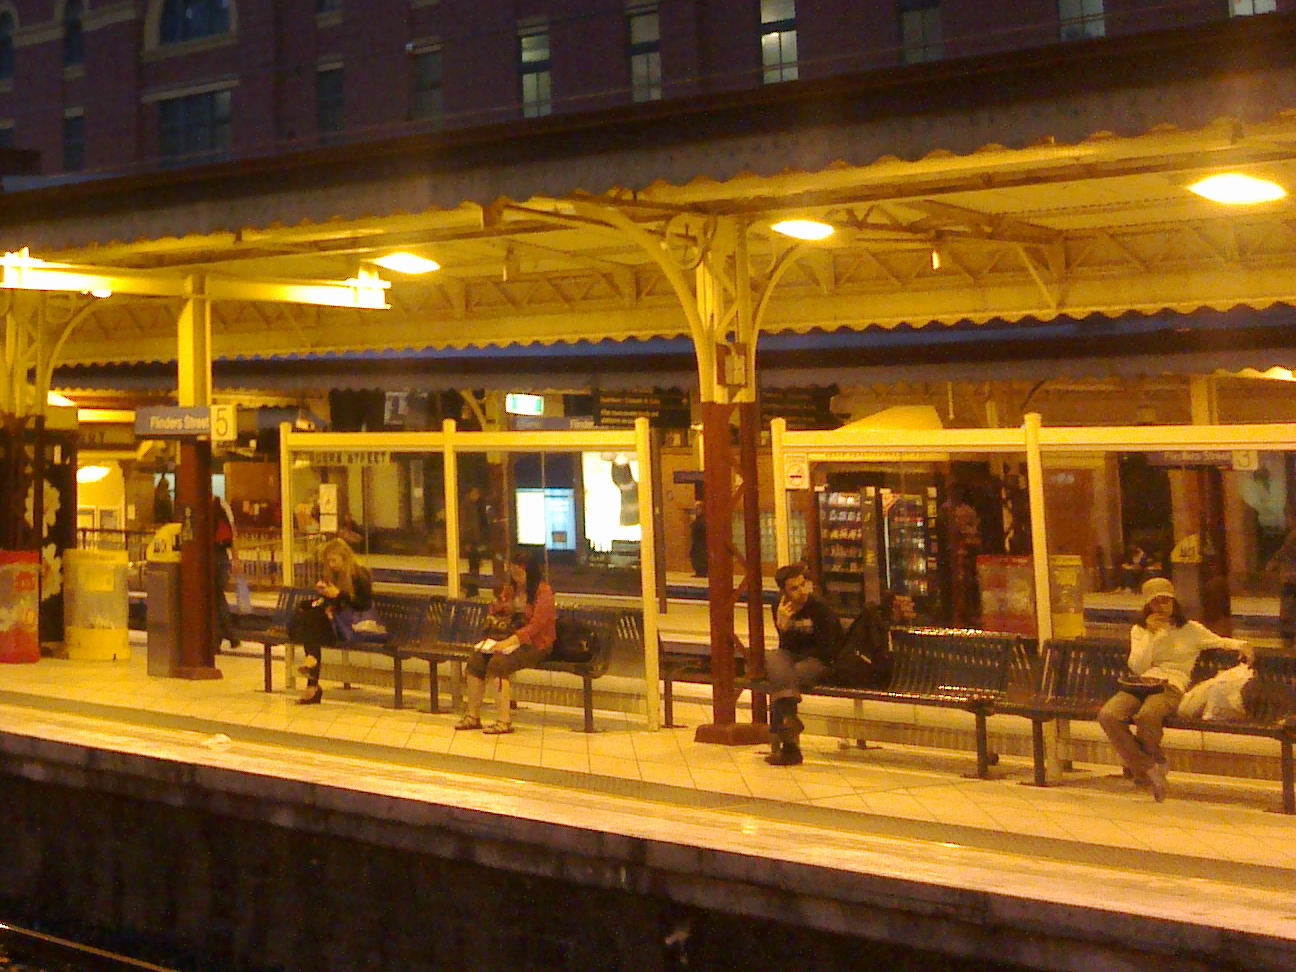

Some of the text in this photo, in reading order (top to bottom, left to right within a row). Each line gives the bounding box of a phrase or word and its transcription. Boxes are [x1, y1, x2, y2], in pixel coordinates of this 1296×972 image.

[150, 416, 183, 430] Flinders
[216, 408, 229, 438] 5
[1238, 451, 1251, 468] 3
